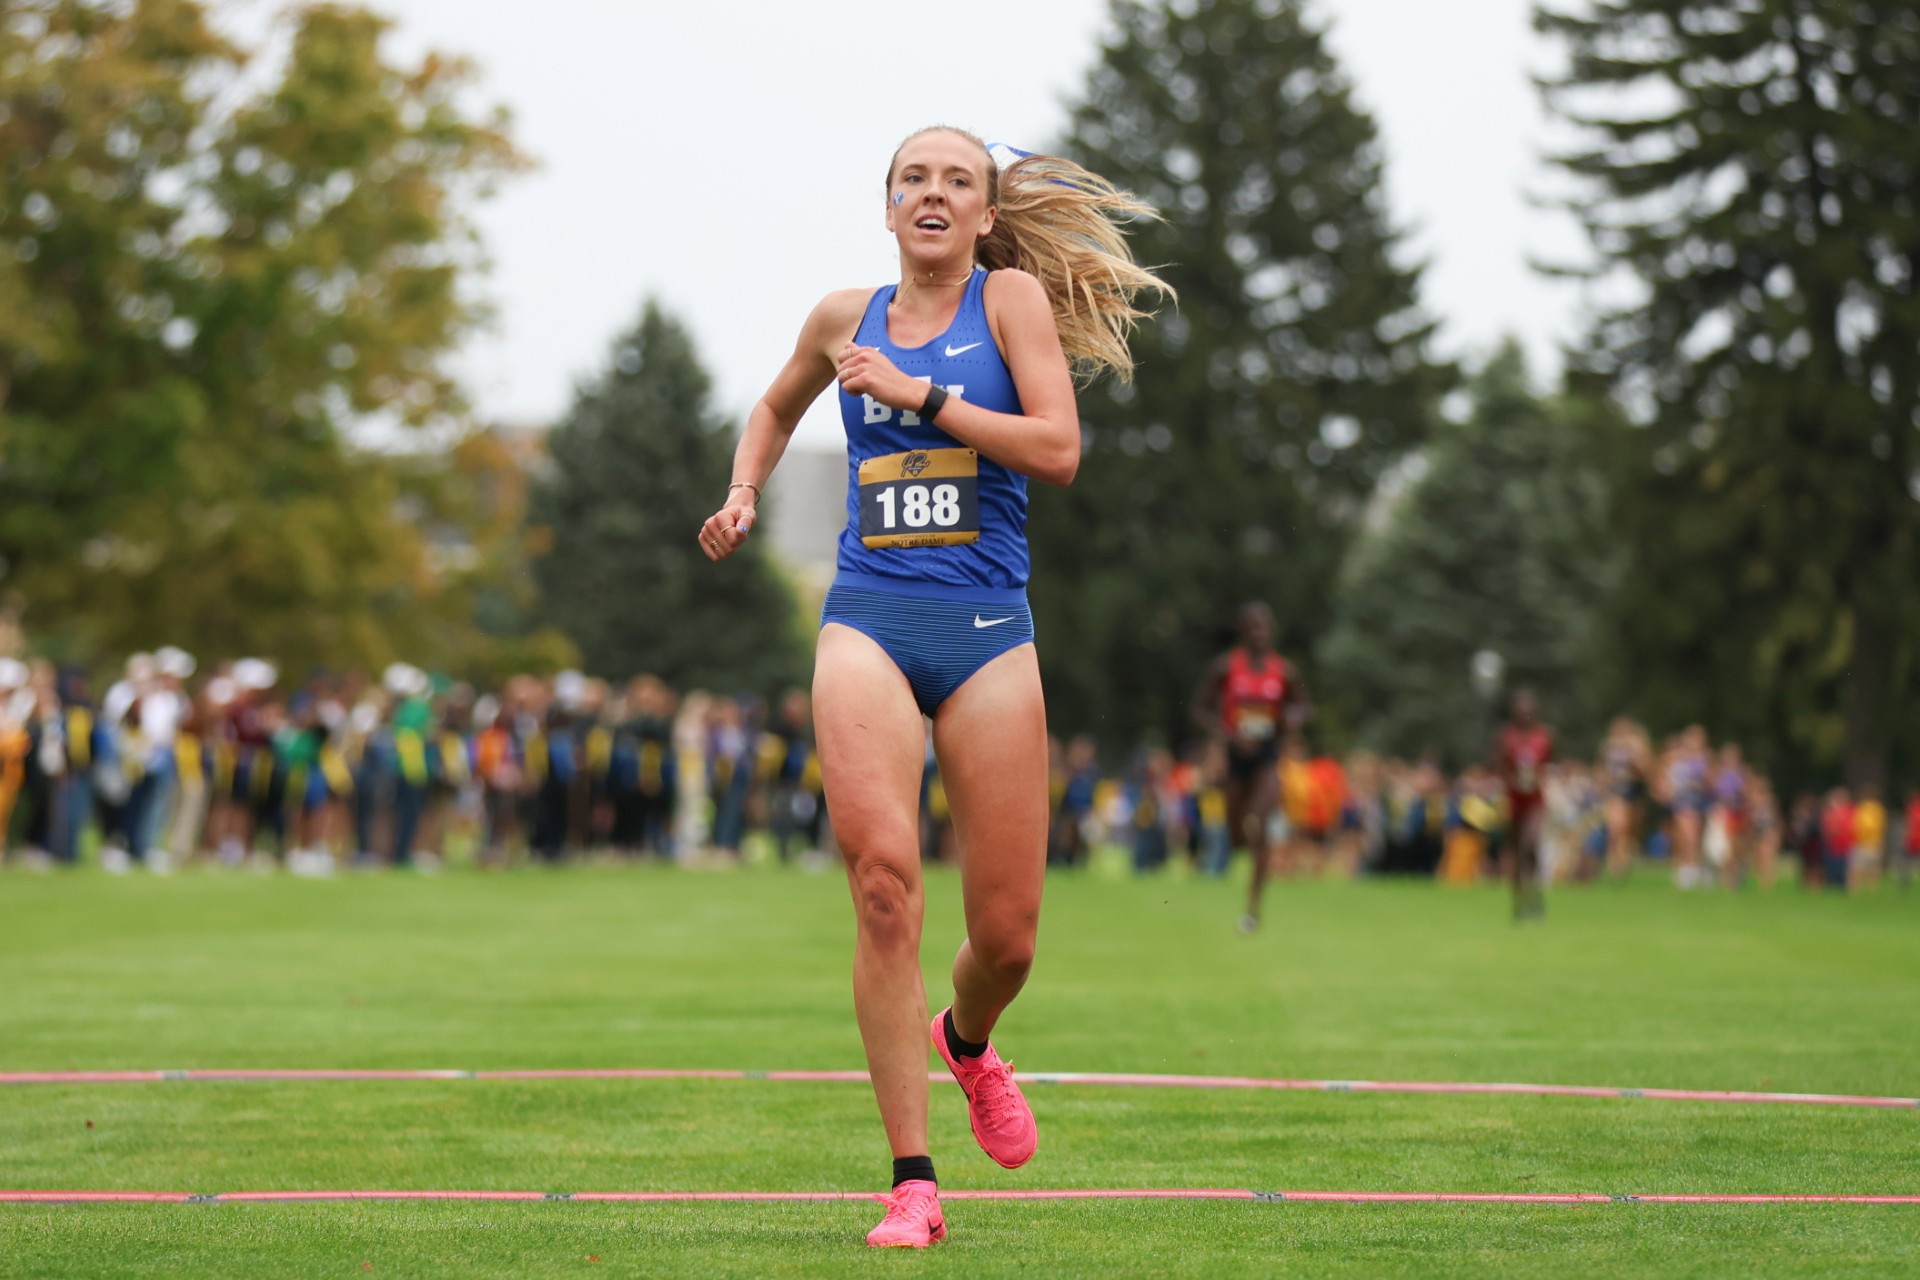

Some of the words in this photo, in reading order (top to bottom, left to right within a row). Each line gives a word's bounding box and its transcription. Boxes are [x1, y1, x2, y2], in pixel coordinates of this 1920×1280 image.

[876, 484, 960, 528] 188
[891, 538, 918, 547] NOTRE
[921, 537, 946, 546] DAME
